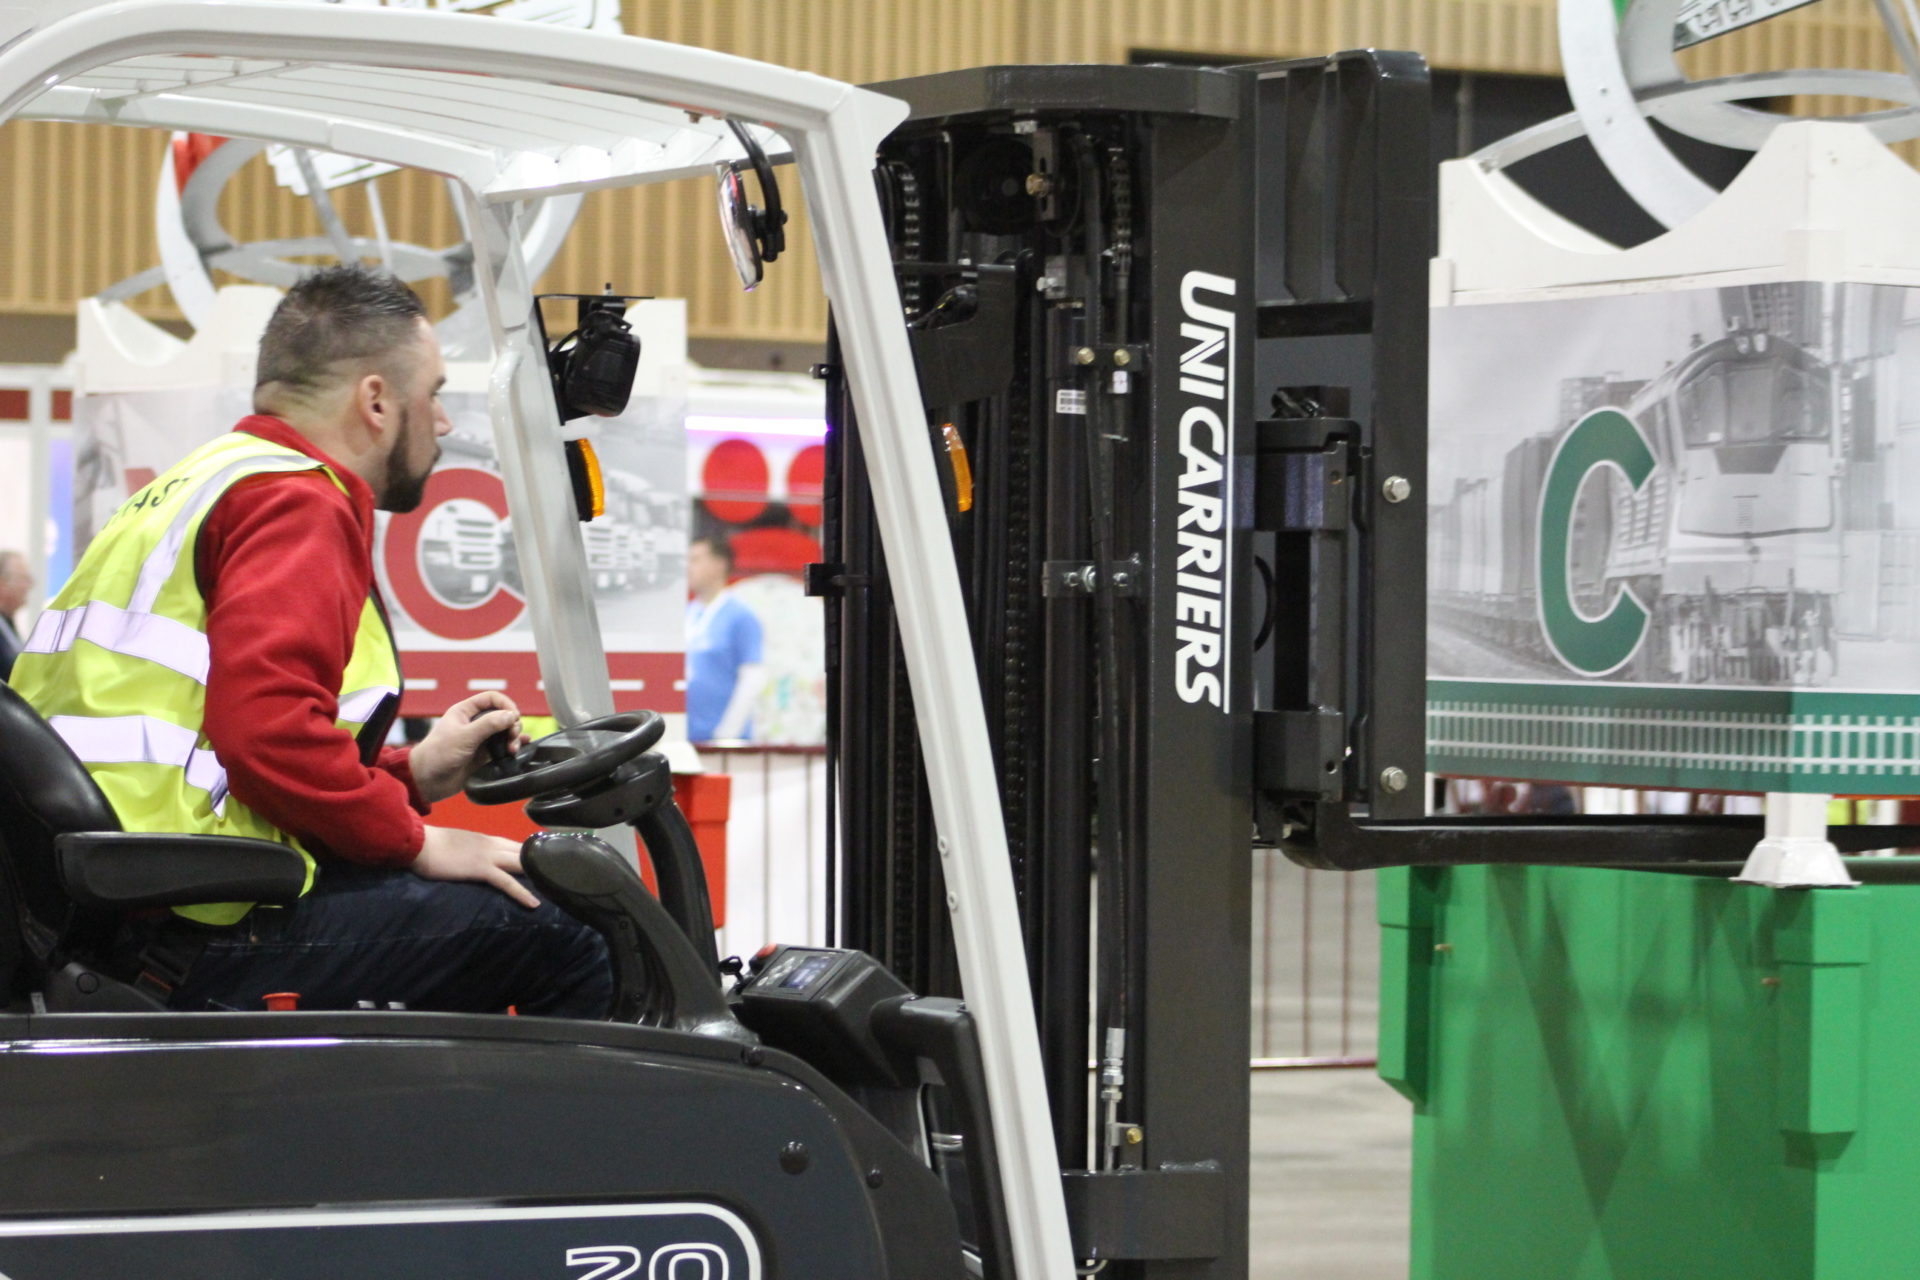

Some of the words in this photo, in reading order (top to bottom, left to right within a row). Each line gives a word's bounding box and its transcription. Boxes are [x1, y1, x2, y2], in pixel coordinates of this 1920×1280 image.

[384, 467, 527, 641] C
[1175, 270, 1236, 712] UNICARRIERS
[1536, 406, 1659, 677] C
